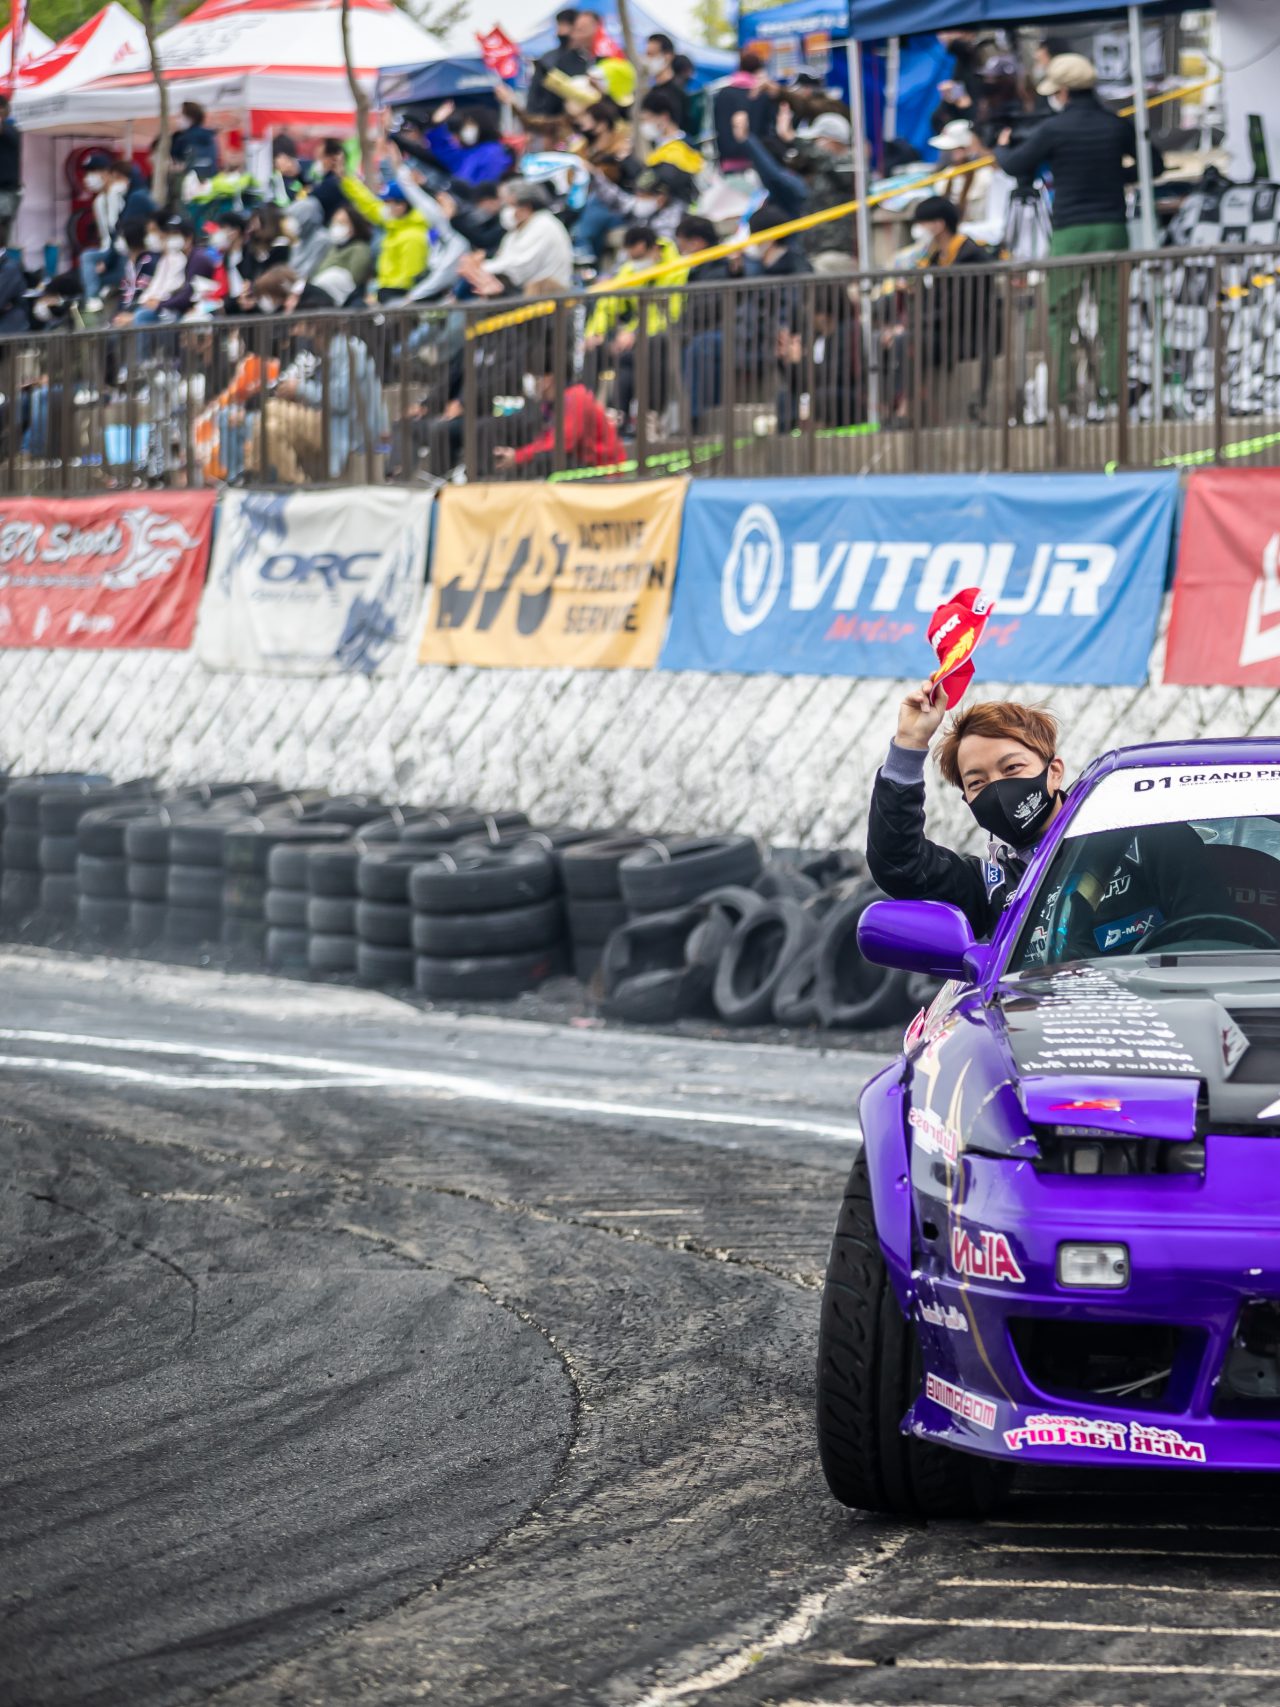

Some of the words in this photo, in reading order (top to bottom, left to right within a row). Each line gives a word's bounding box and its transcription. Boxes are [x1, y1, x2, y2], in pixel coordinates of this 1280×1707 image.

[576, 518, 647, 553] ACTIVE
[259, 551, 382, 591] ORC
[790, 541, 1117, 617] VITOUR
[1134, 776, 1172, 793] D1
[1179, 771, 1251, 783] GRAND
[1104, 914, 1155, 948] D-MAX
